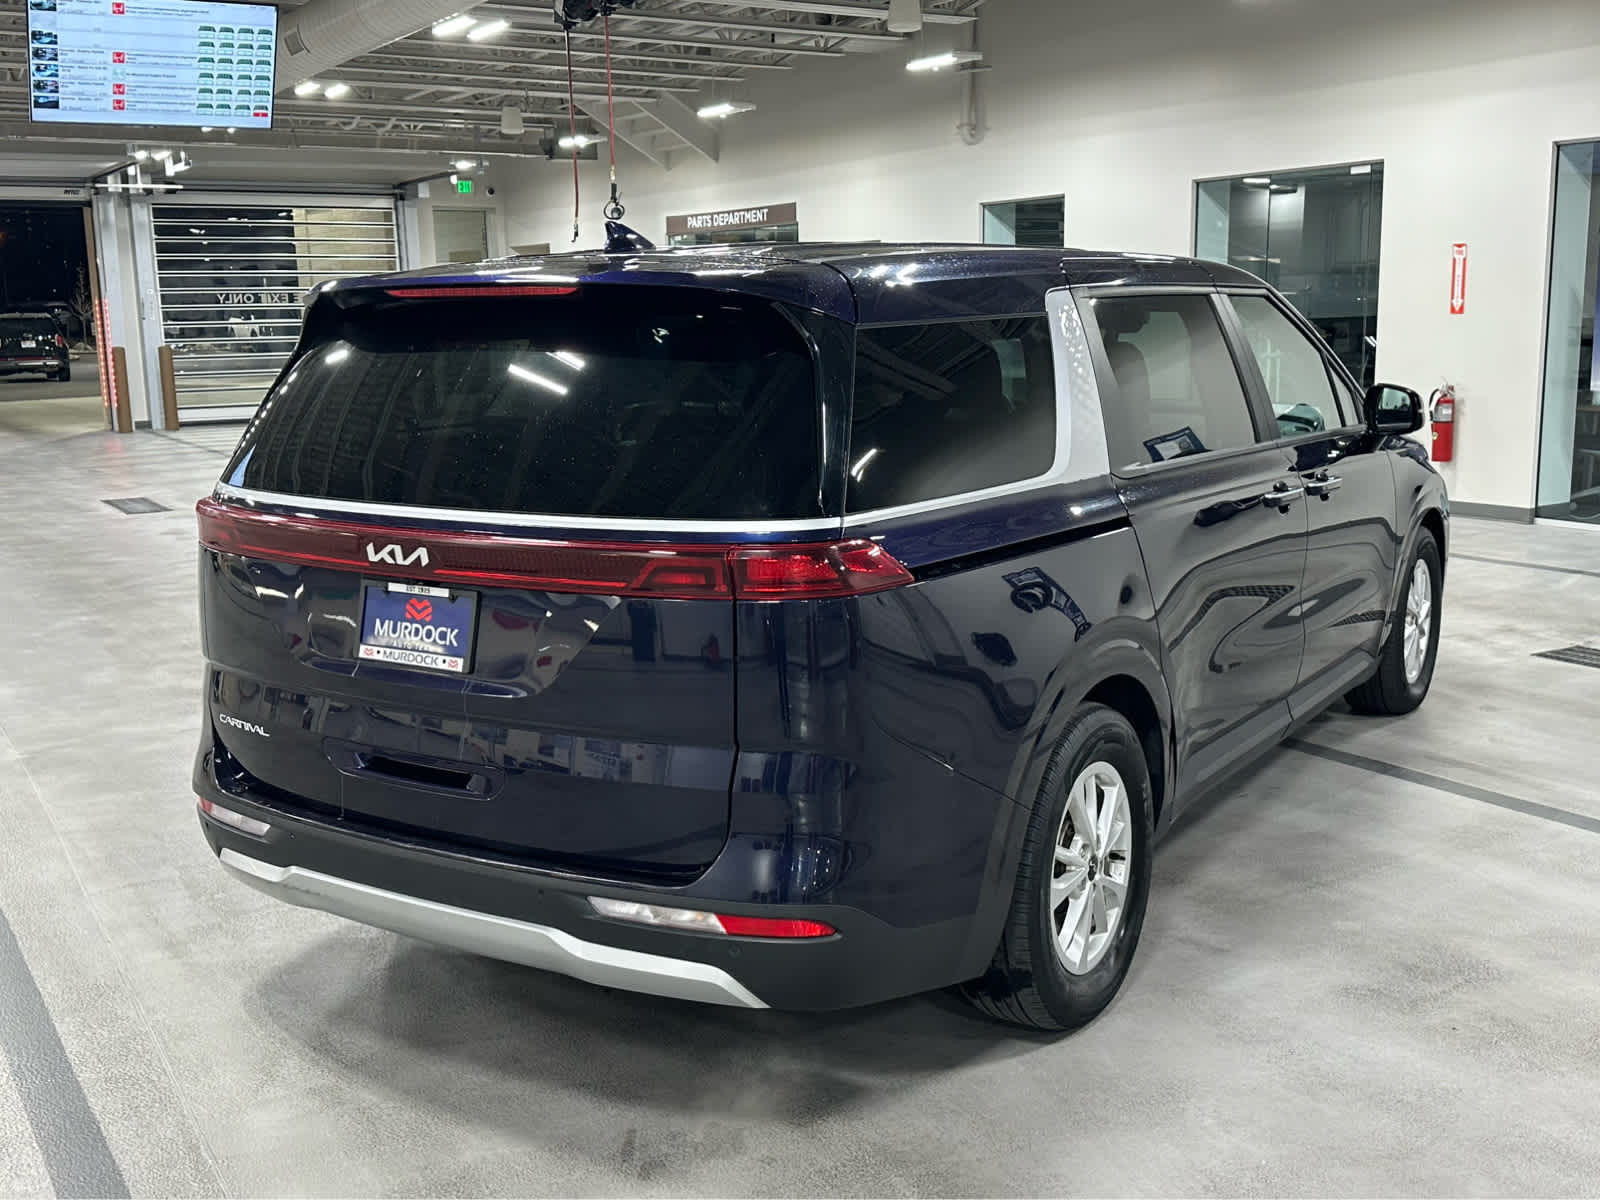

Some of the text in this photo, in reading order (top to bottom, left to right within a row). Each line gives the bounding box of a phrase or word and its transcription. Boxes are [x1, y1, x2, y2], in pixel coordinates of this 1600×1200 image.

[687, 208, 769, 229] PARTS DEPARTMENT
[366, 541, 430, 567] KIA
[374, 618, 459, 647] MURDOCK
[382, 649, 440, 666] MURDOCK
[219, 713, 270, 737] CARNIVAL
